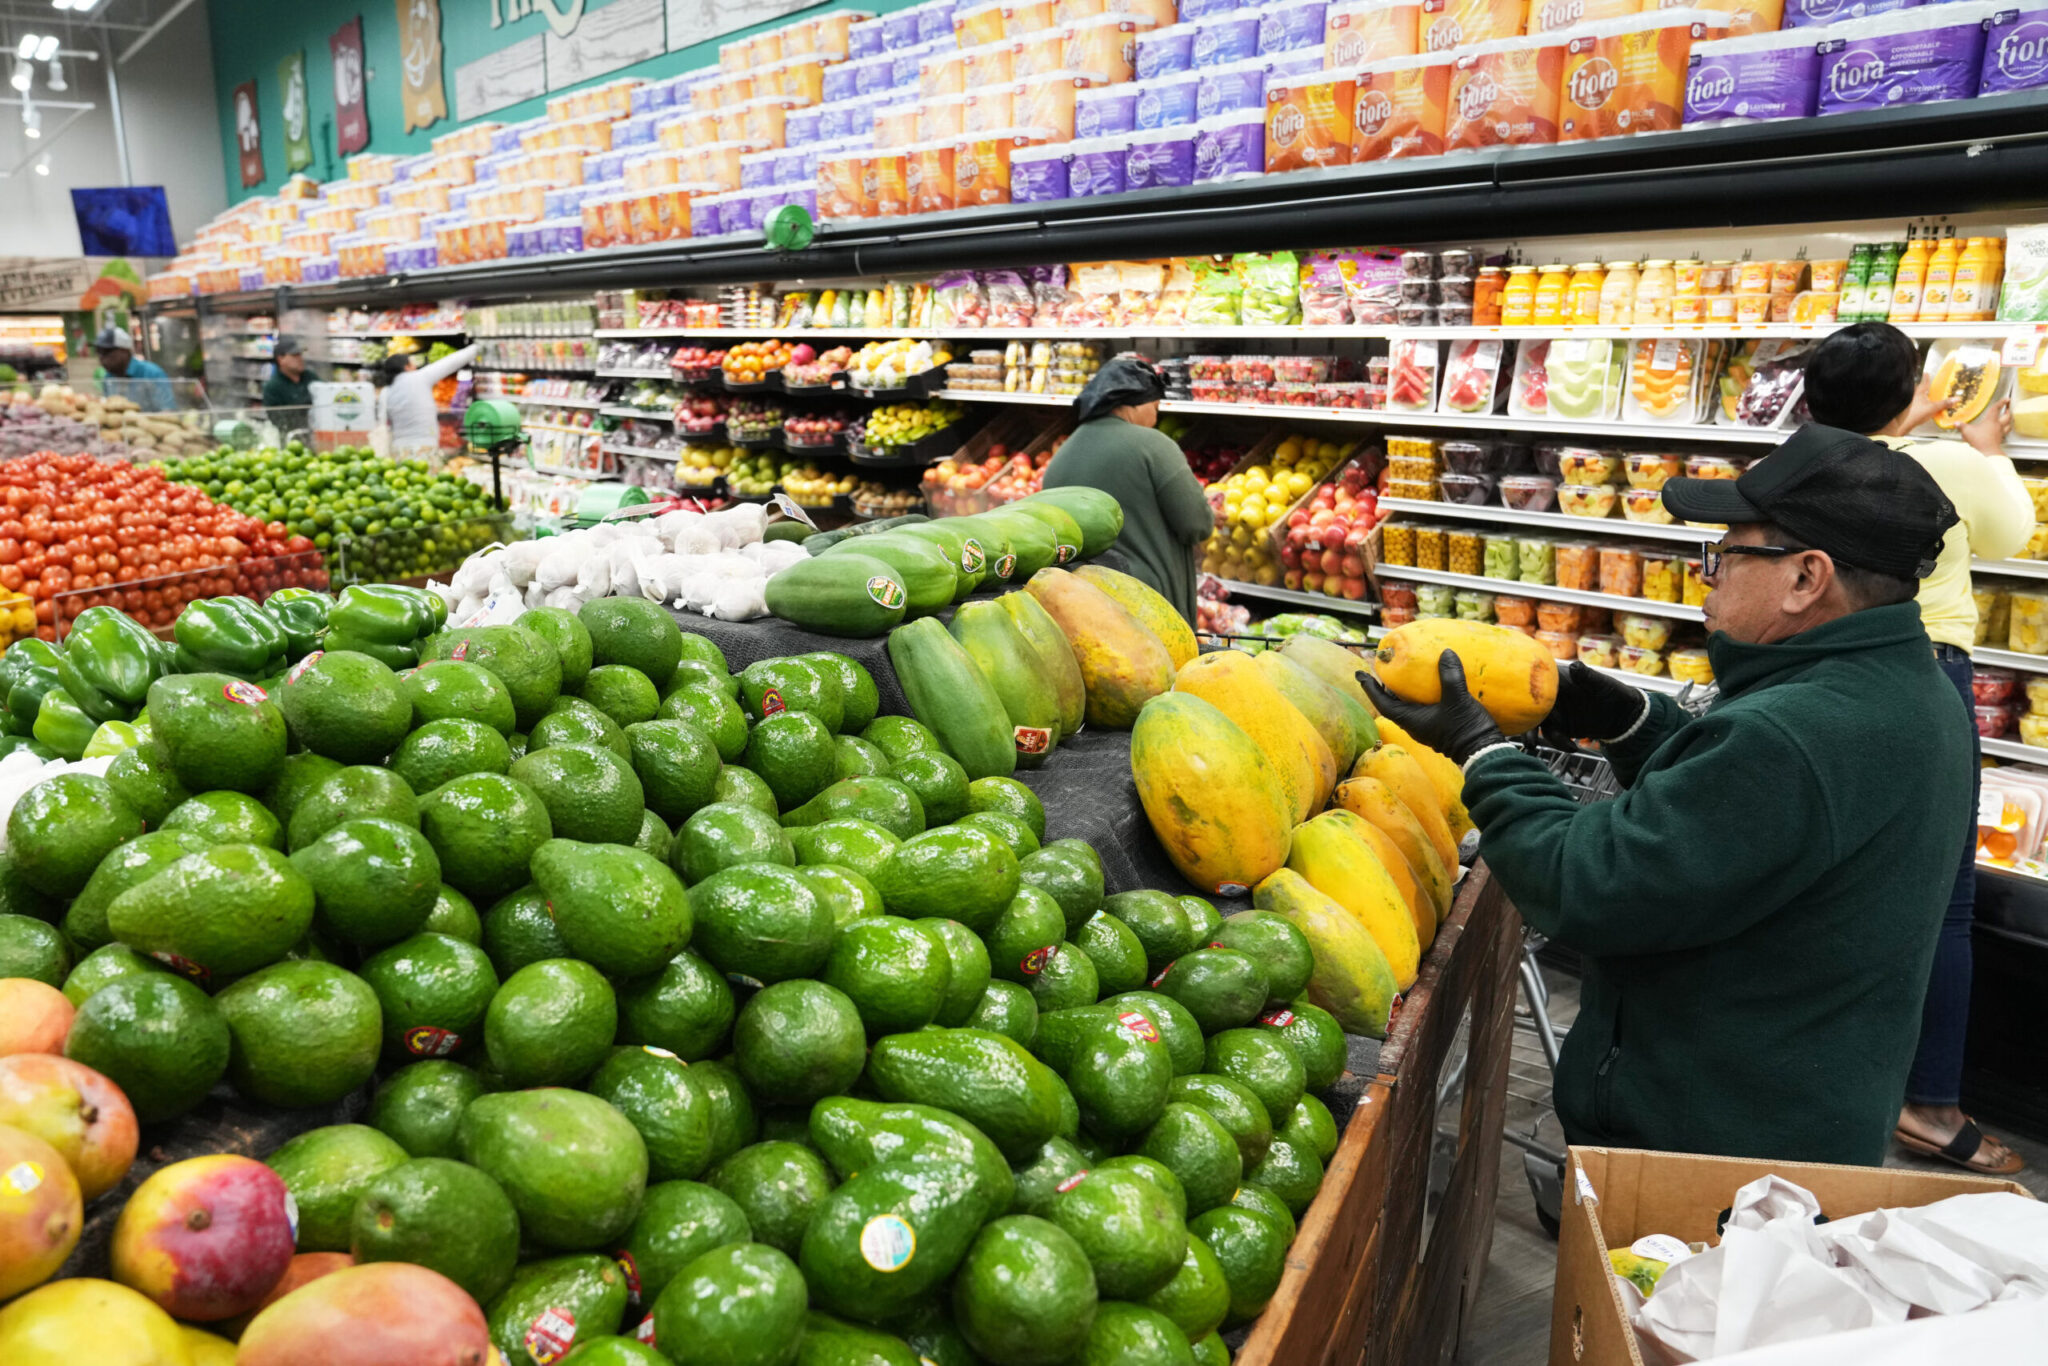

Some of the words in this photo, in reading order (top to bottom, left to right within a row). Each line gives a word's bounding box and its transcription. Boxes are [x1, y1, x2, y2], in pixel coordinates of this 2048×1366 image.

[1540, 0, 1585, 31] fiora
[1425, 24, 1463, 50] fiora
[1996, 35, 2048, 68] fior
[1332, 38, 1366, 66] fiora
[1568, 68, 1618, 101] fiora
[1687, 76, 1734, 104] fiora
[1828, 61, 1884, 92] fiora
[1456, 83, 1497, 115] fiora
[1271, 113, 1304, 140] fiora
[1354, 100, 1391, 128] fiora
